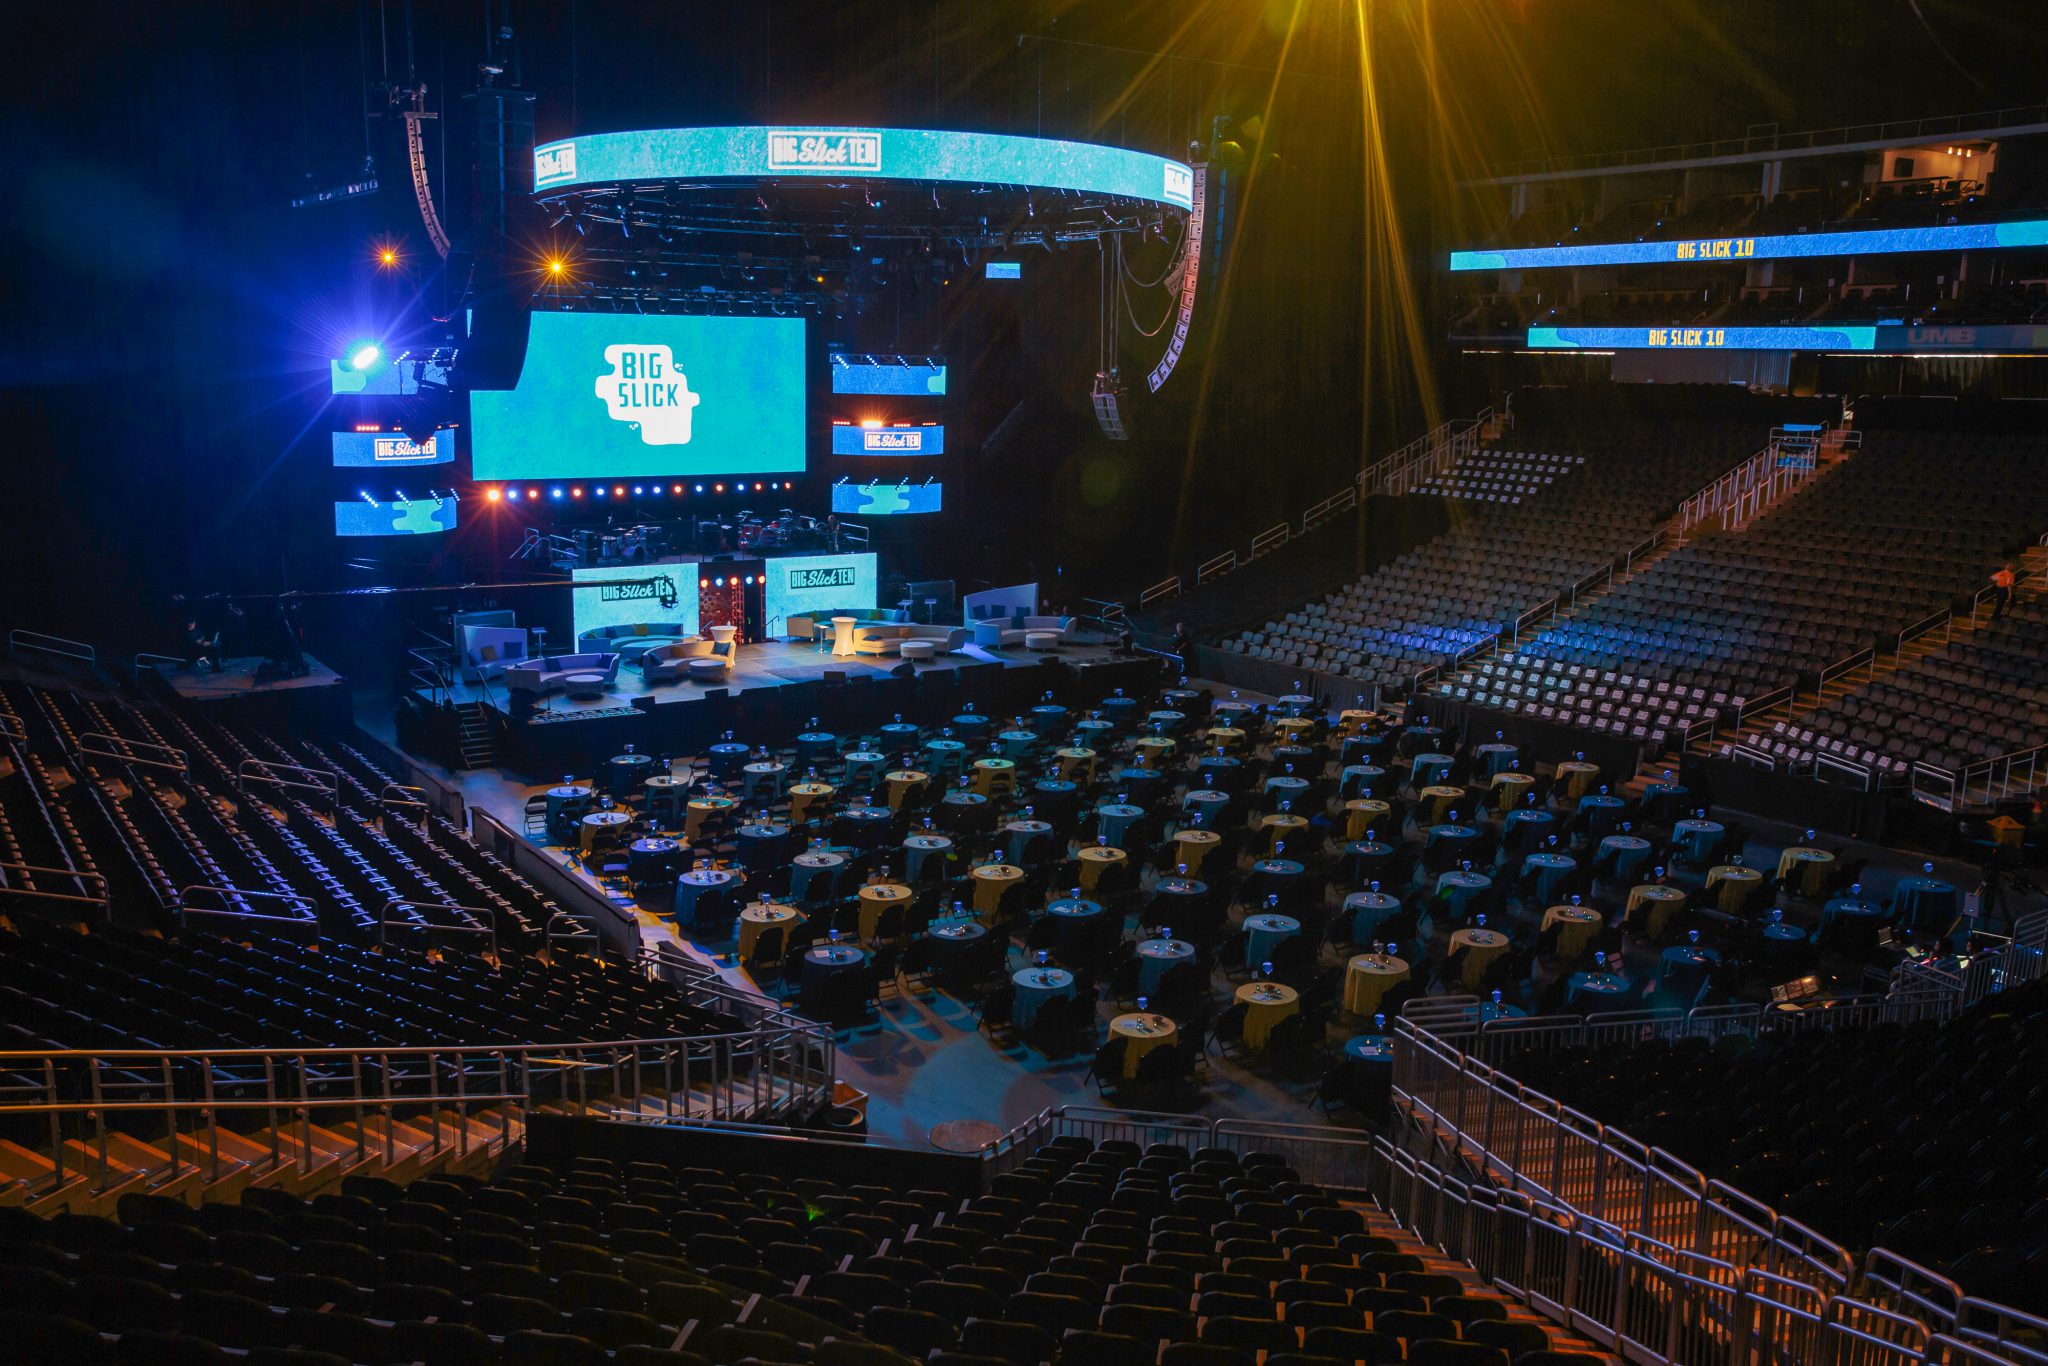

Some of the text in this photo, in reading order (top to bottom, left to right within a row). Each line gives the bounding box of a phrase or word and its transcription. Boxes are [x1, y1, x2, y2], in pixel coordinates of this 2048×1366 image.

[799, 137, 847, 163] Slick
[848, 138, 876, 164] TEN
[1677, 239, 1754, 258] BIG SLICK 10
[1649, 330, 1724, 346] BIG SLICK 10
[1907, 328, 1976, 343] UMB
[622, 352, 662, 379] BIG
[619, 383, 678, 407] SLICK
[881, 434, 905, 447] Slick
[792, 568, 854, 588] BIG Slick TEN
[602, 586, 620, 600] BIG
[620, 585, 654, 598] Slick
